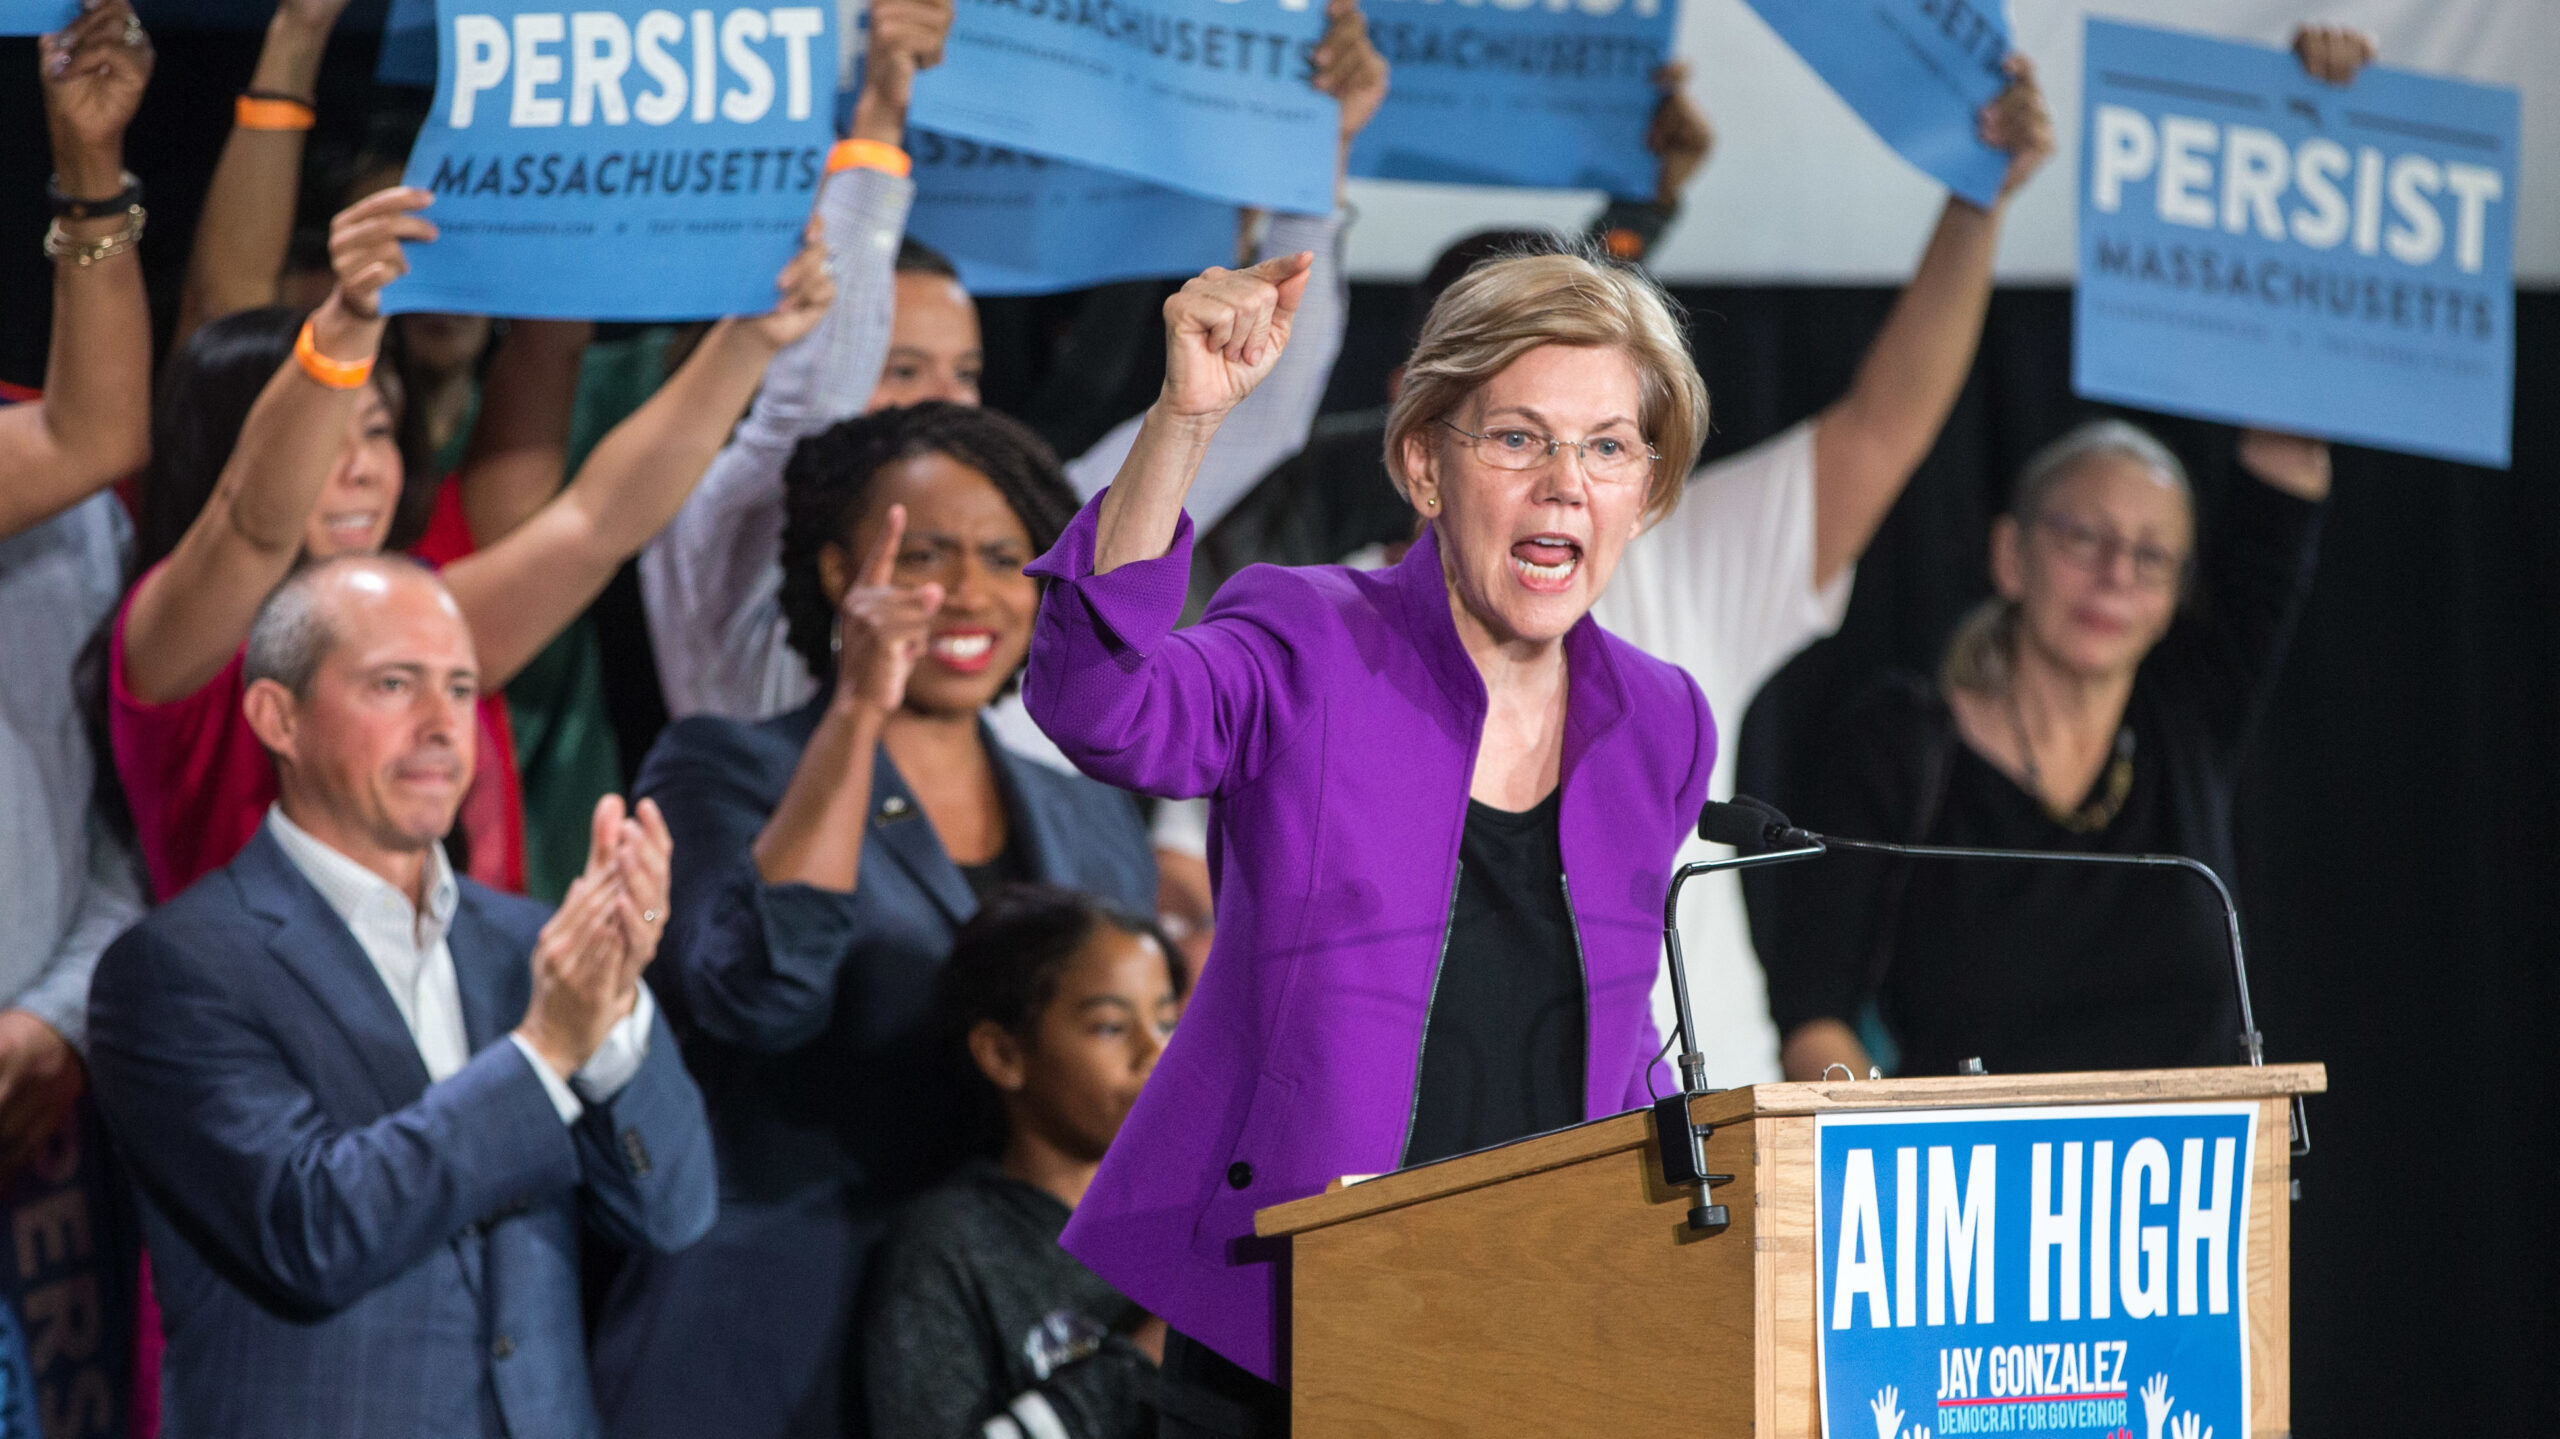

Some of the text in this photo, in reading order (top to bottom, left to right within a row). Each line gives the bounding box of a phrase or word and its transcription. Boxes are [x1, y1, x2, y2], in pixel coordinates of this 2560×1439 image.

[449, 8, 823, 129] PERSIST
[430, 146, 820, 198] MASSACHUSETTS
[2093, 103, 2502, 275] PERSIST
[2095, 235, 2494, 343] MASSACHUSETTS
[1832, 1137, 2237, 1330] AIM HIGH
[1937, 1340, 2128, 1400] JAY GONZALEZ
[1938, 1399, 2128, 1435] DEMOCRAT FOR GOVERNOR
